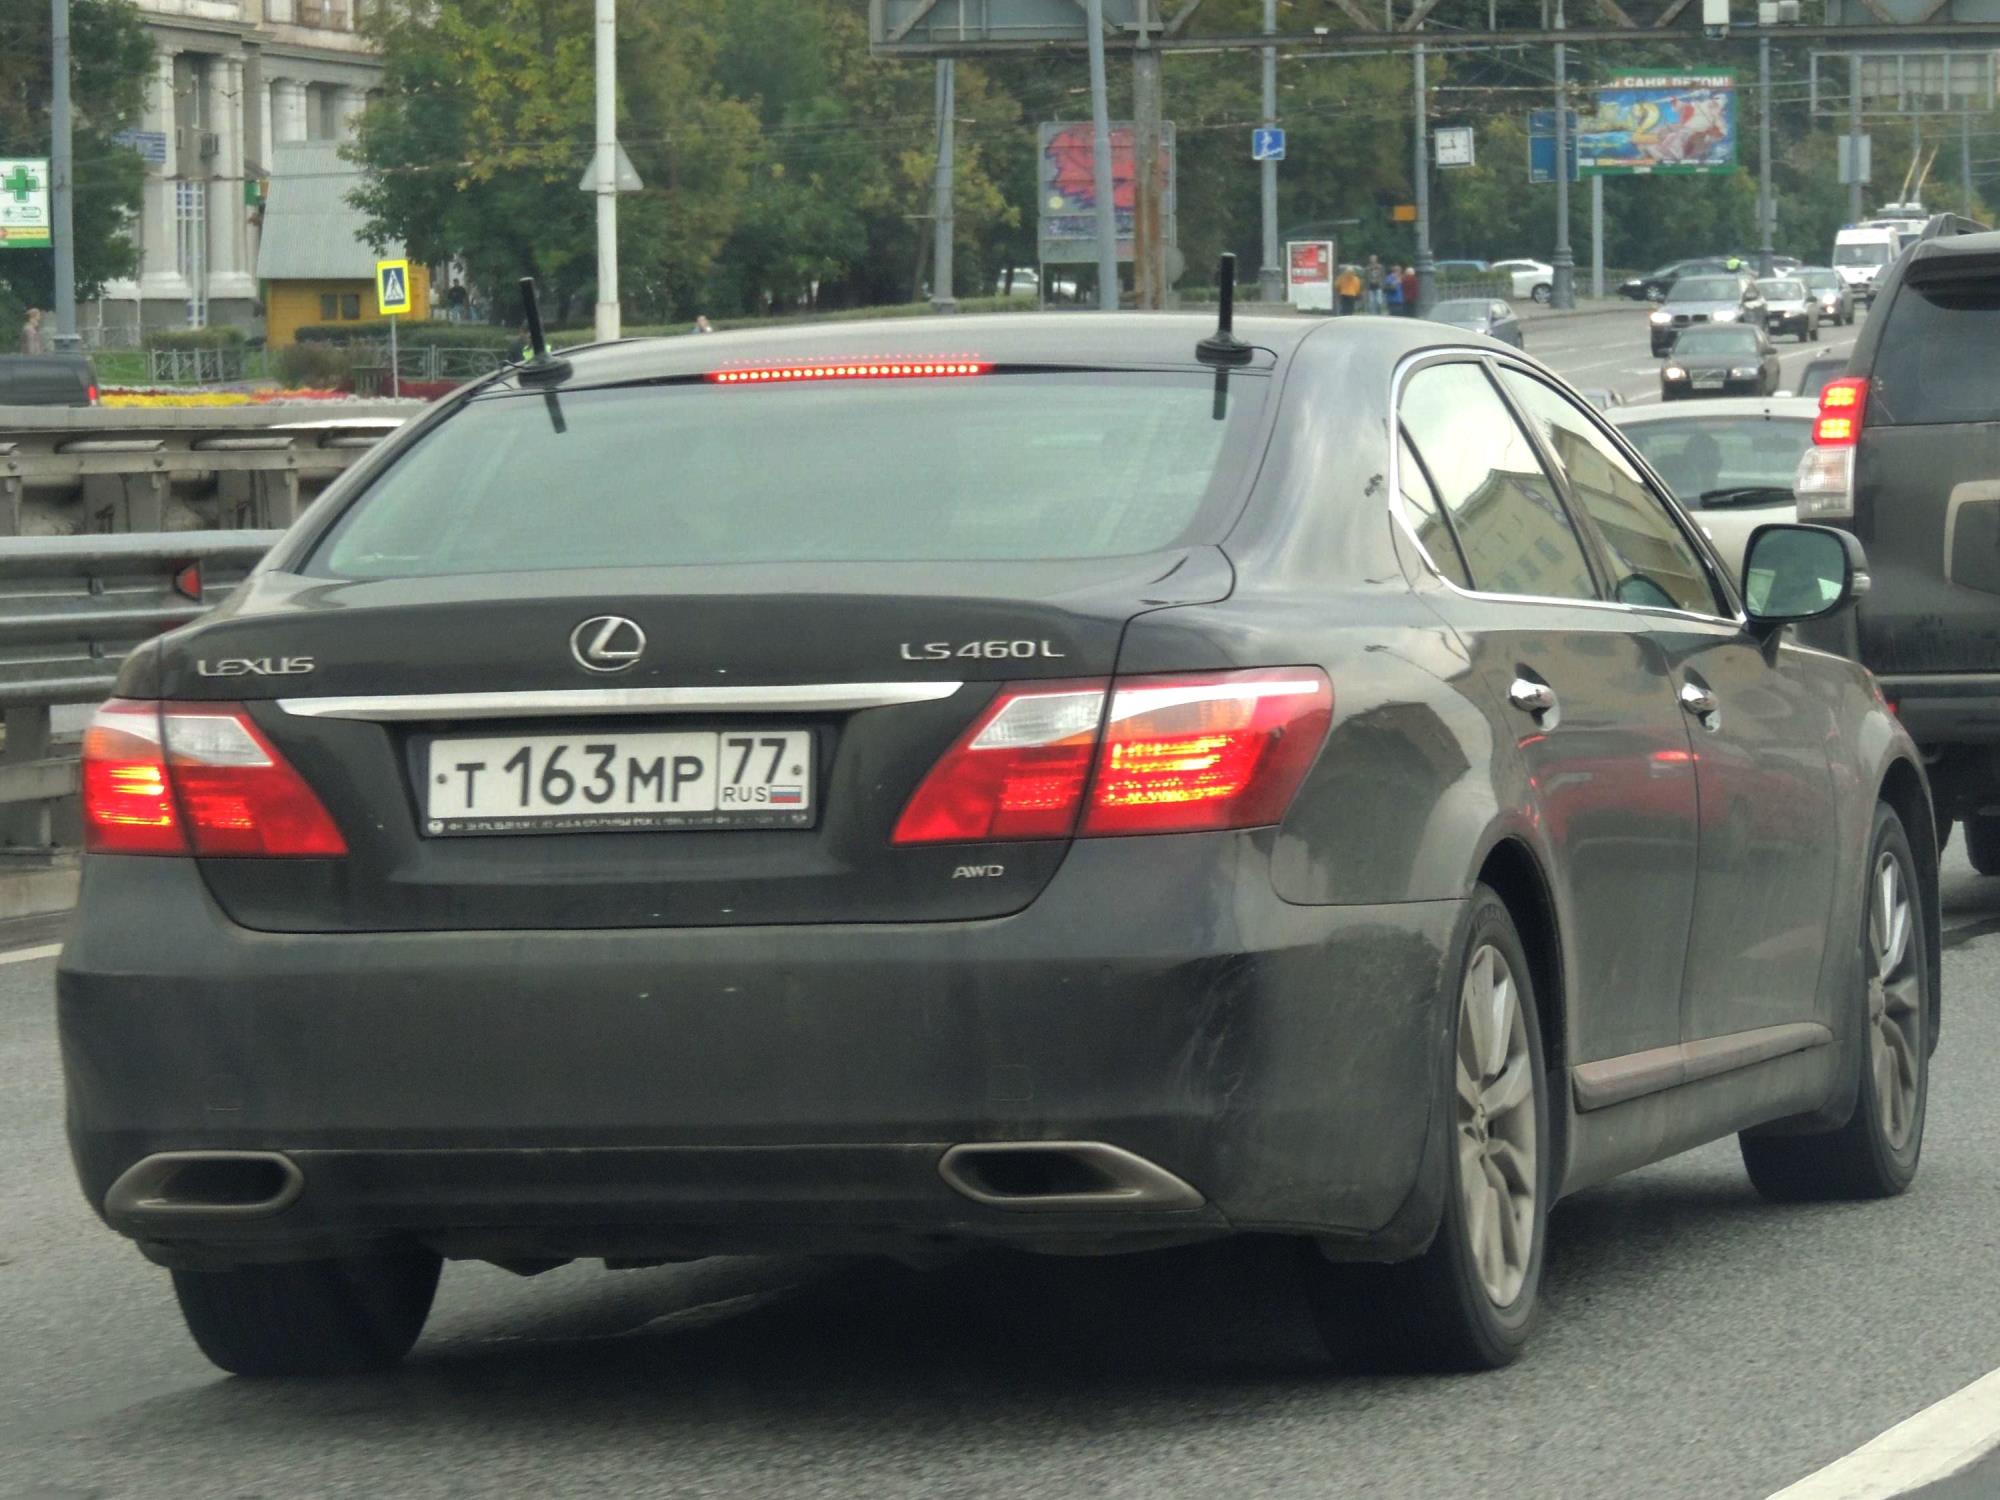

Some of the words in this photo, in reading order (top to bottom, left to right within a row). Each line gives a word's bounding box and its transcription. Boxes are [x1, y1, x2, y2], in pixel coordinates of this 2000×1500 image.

[197, 657, 315, 676] LEXUS
[727, 738, 787, 785] 77
[722, 786, 768, 803] RUS
[951, 864, 1004, 879] AWD
